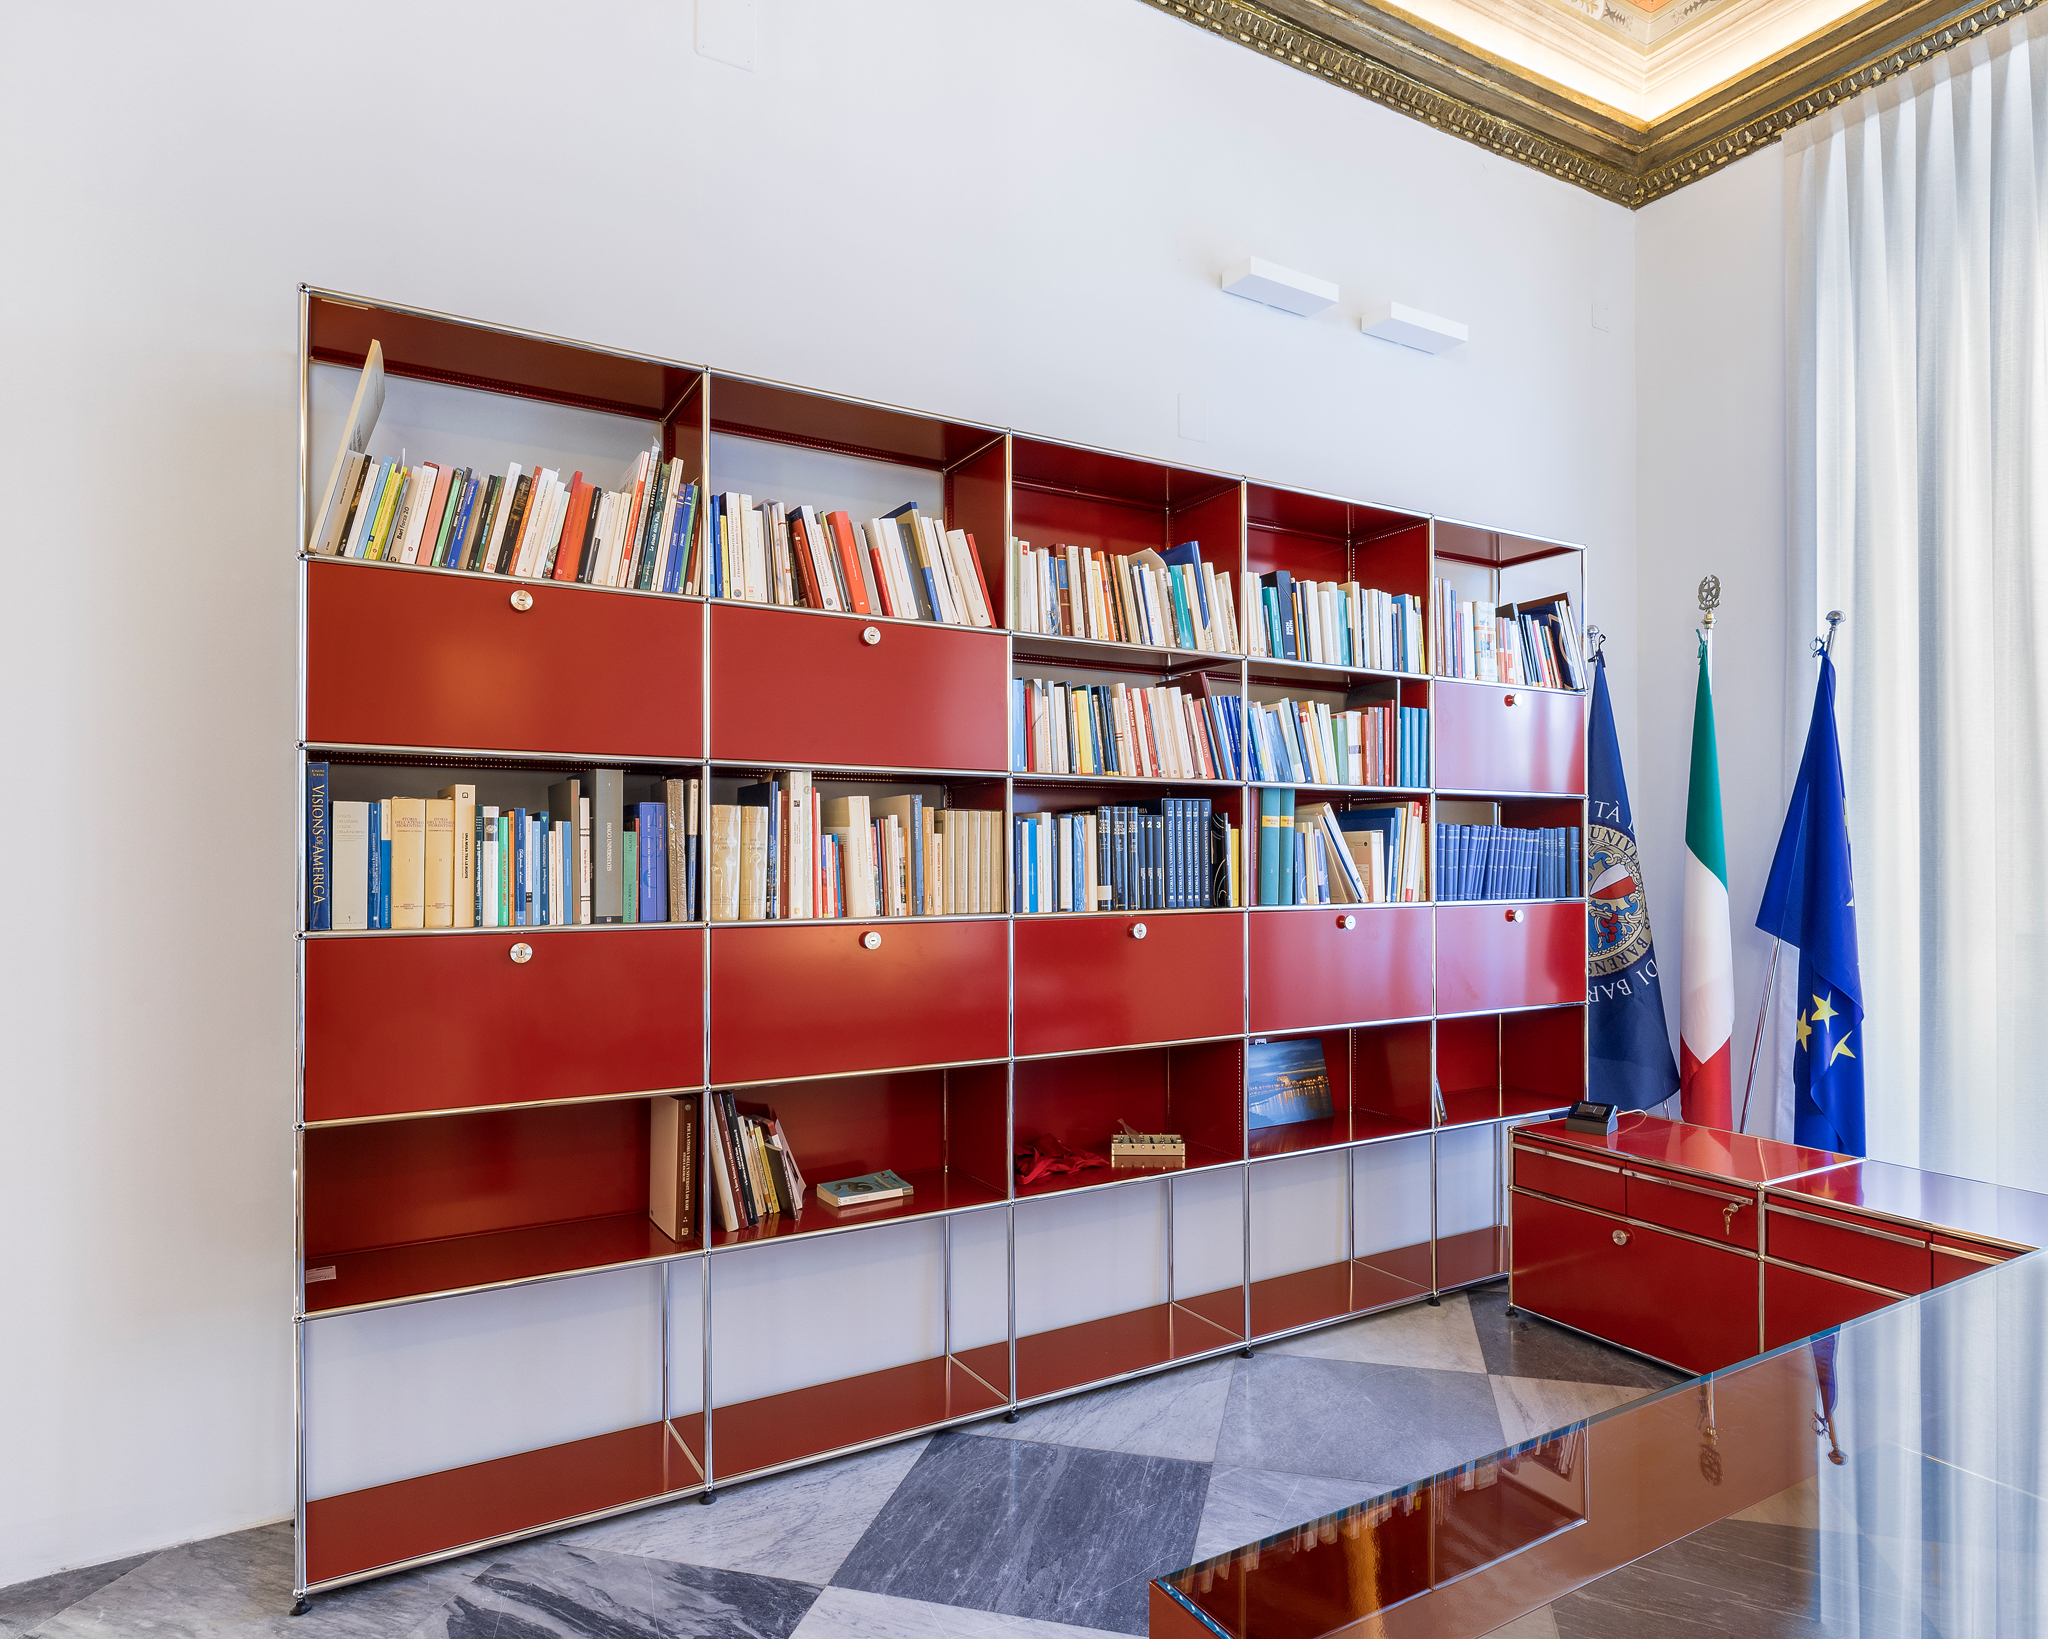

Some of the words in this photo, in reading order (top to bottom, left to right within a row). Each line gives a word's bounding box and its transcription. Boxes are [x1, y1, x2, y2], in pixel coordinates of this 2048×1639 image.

[399, 514, 409, 529] forza
[403, 506, 410, 515] 20
[396, 528, 405, 540] Bari
[311, 784, 326, 835] VISIONS
[315, 836, 323, 845] OF
[1590, 827, 1640, 866] UNIVE
[312, 845, 326, 905] AMERICA
[1588, 937, 1648, 974] BARENS
[1636, 958, 1658, 986] DI
